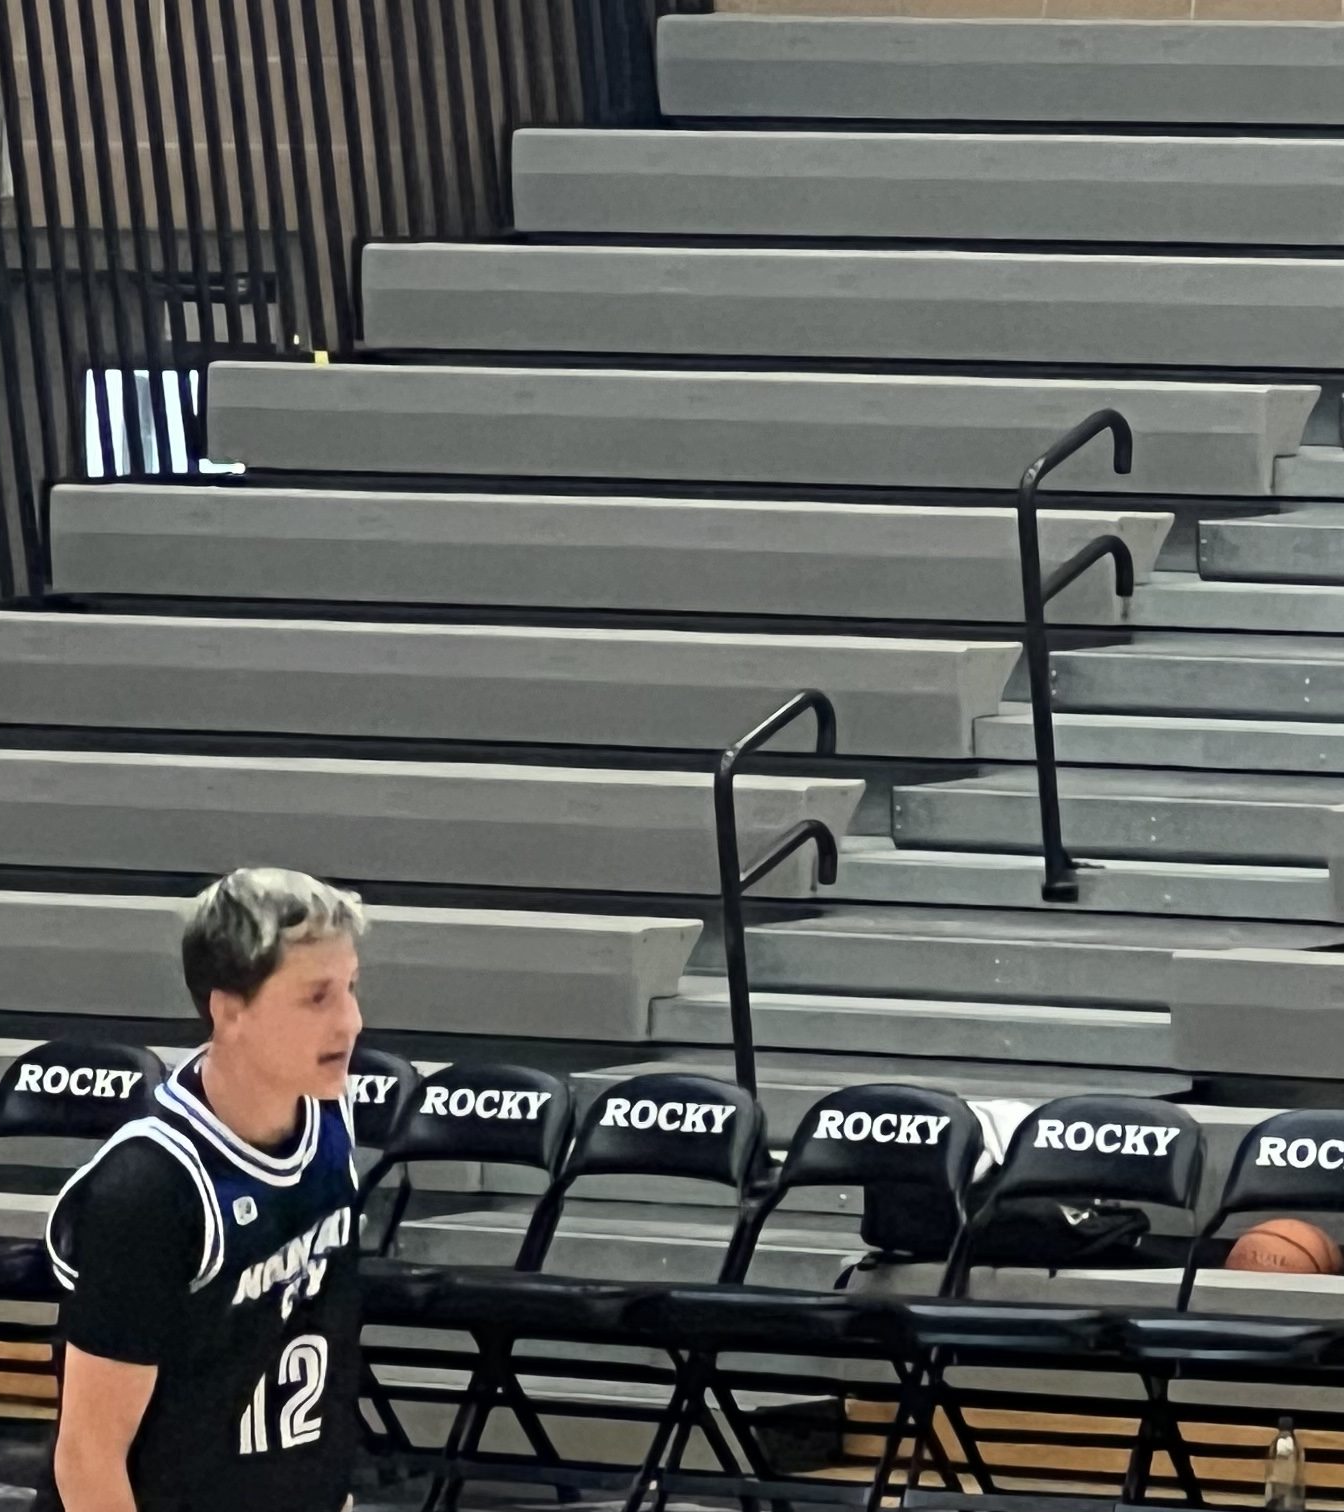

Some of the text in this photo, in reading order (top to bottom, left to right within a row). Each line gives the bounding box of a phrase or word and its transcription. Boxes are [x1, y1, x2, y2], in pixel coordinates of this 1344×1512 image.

[14, 1063, 143, 1099] ROCKY
[419, 1086, 552, 1120] ROCKY
[599, 1097, 737, 1134] ROCKY
[812, 1109, 952, 1145] ROCKY
[1032, 1118, 1181, 1157] ROCKY
[239, 1334, 329, 1455] 12
